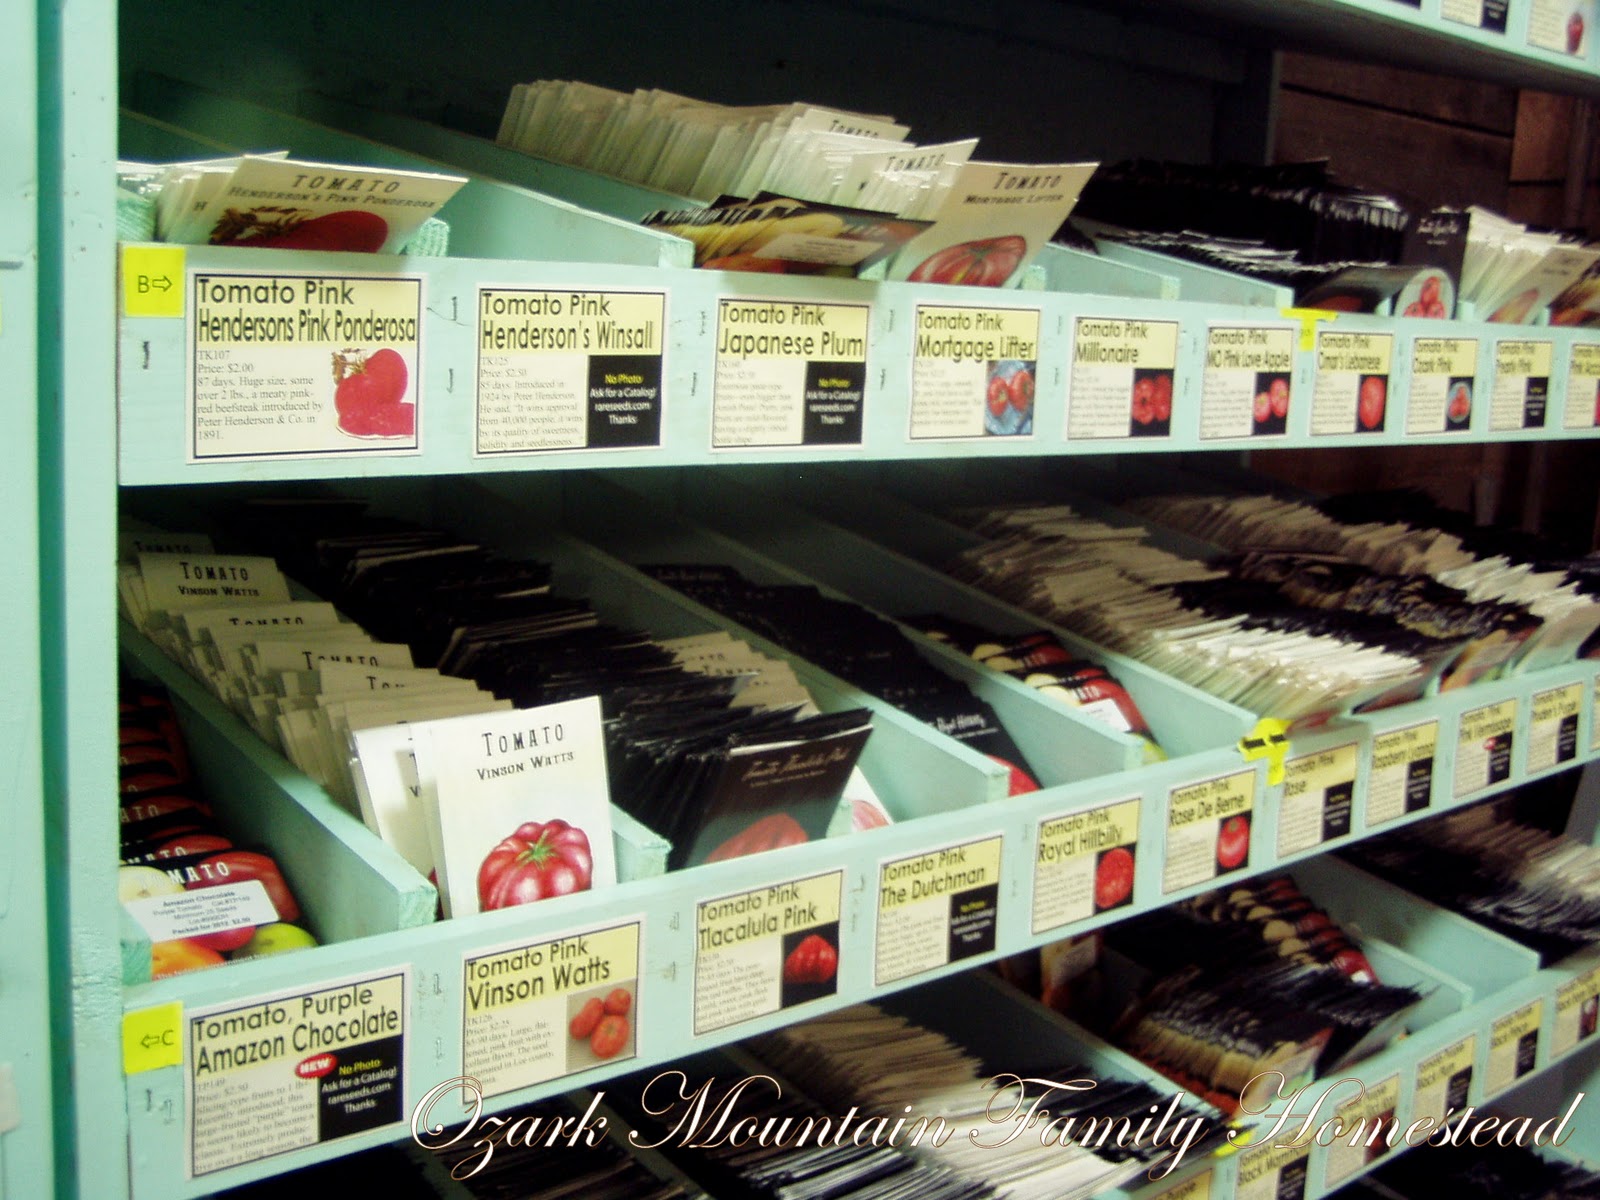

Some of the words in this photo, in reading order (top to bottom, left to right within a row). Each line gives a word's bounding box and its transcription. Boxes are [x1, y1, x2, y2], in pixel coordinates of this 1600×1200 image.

[293, 174, 401, 193] TOMATO
[993, 172, 1061, 190] TOMATO
[138, 275, 150, 293] B
[199, 278, 295, 304] Tomato
[304, 280, 354, 305] Pink
[482, 293, 562, 315] Tomato
[570, 294, 610, 316] Pink
[721, 302, 785, 324] Tomato
[791, 305, 826, 326] Pink
[199, 307, 294, 342] Hendersons
[299, 308, 331, 342] Pink
[334, 309, 416, 342] Ponderosa
[918, 310, 971, 330] Tomato
[976, 313, 1003, 331] Pink
[1076, 320, 1121, 338] Tomato
[1124, 321, 1148, 339] Pink
[482, 320, 590, 349] Henderson's
[597, 320, 653, 349] Winsall
[719, 328, 814, 360] Japanese
[821, 331, 863, 356] Plum
[1208, 329, 1246, 345] Tomato
[1248, 330, 1268, 345] Pink
[916, 335, 994, 363] Mortgage
[1000, 335, 1034, 358] Lifter
[1075, 342, 1139, 363] Millionaire
[198, 364, 224, 374] Price:
[228, 363, 254, 374] $2.00
[1225, 352, 1241, 367] Pink
[1242, 351, 1262, 368] Love
[1263, 352, 1290, 372] Apple
[239, 376, 264, 388] Huge
[290, 377, 314, 385] some
[605, 373, 617, 384] No
[618, 373, 644, 384] Photo
[198, 392, 218, 401] over
[260, 389, 287, 401] meaty
[605, 387, 616, 398] for
[197, 404, 213, 414] red
[215, 403, 259, 413] beefsteak
[262, 401, 310, 412] introduced
[312, 401, 323, 414] by
[198, 416, 222, 427] Peter
[225, 415, 274, 426] Henderson
[277, 415, 285, 425] &
[307, 414, 316, 423] in
[609, 414, 637, 425] Thanks
[180, 562, 249, 581] TOMATO
[178, 585, 218, 597] VINSON
[481, 723, 564, 757] TOMATO
[477, 761, 524, 781] VINSON
[530, 751, 575, 769] WATTS
[1172, 787, 1208, 805] Tomato
[1211, 779, 1230, 794] Pink
[1170, 808, 1195, 827] Rose
[1198, 803, 1213, 819] De
[1215, 794, 1245, 815] Berne
[1040, 817, 1084, 839] Tomato
[1087, 809, 1110, 826] Pink
[1038, 839, 1075, 863] Royal
[1079, 825, 1123, 851] Hillbilly
[882, 854, 935, 883] Tomato
[938, 846, 966, 868] Pink
[881, 886, 907, 908] The
[911, 867, 985, 900] Dutchman
[700, 891, 762, 922] Tomato
[768, 881, 800, 906] Pink
[700, 913, 778, 950] Tlacalula
[784, 902, 817, 929] Pink
[468, 946, 543, 981] Tomato
[550, 935, 589, 963] Pink
[468, 975, 544, 1011] Vinson
[552, 956, 610, 991] Watts
[195, 1005, 293, 1042] Tomato,
[302, 984, 373, 1018] Purple
[161, 1029, 175, 1045] C
[196, 1036, 285, 1077] Amazon
[292, 1007, 398, 1052] Chocolate
[300, 1057, 330, 1074] NEW
[339, 1066, 353, 1076] No
[354, 1059, 382, 1072] Photo
[322, 1081, 339, 1093] Ask
[339, 1078, 352, 1088] for
[361, 1066, 398, 1084] Catalog!
[327, 1081, 392, 1105] rareseeds.com
[344, 1098, 377, 1114] Thanks
